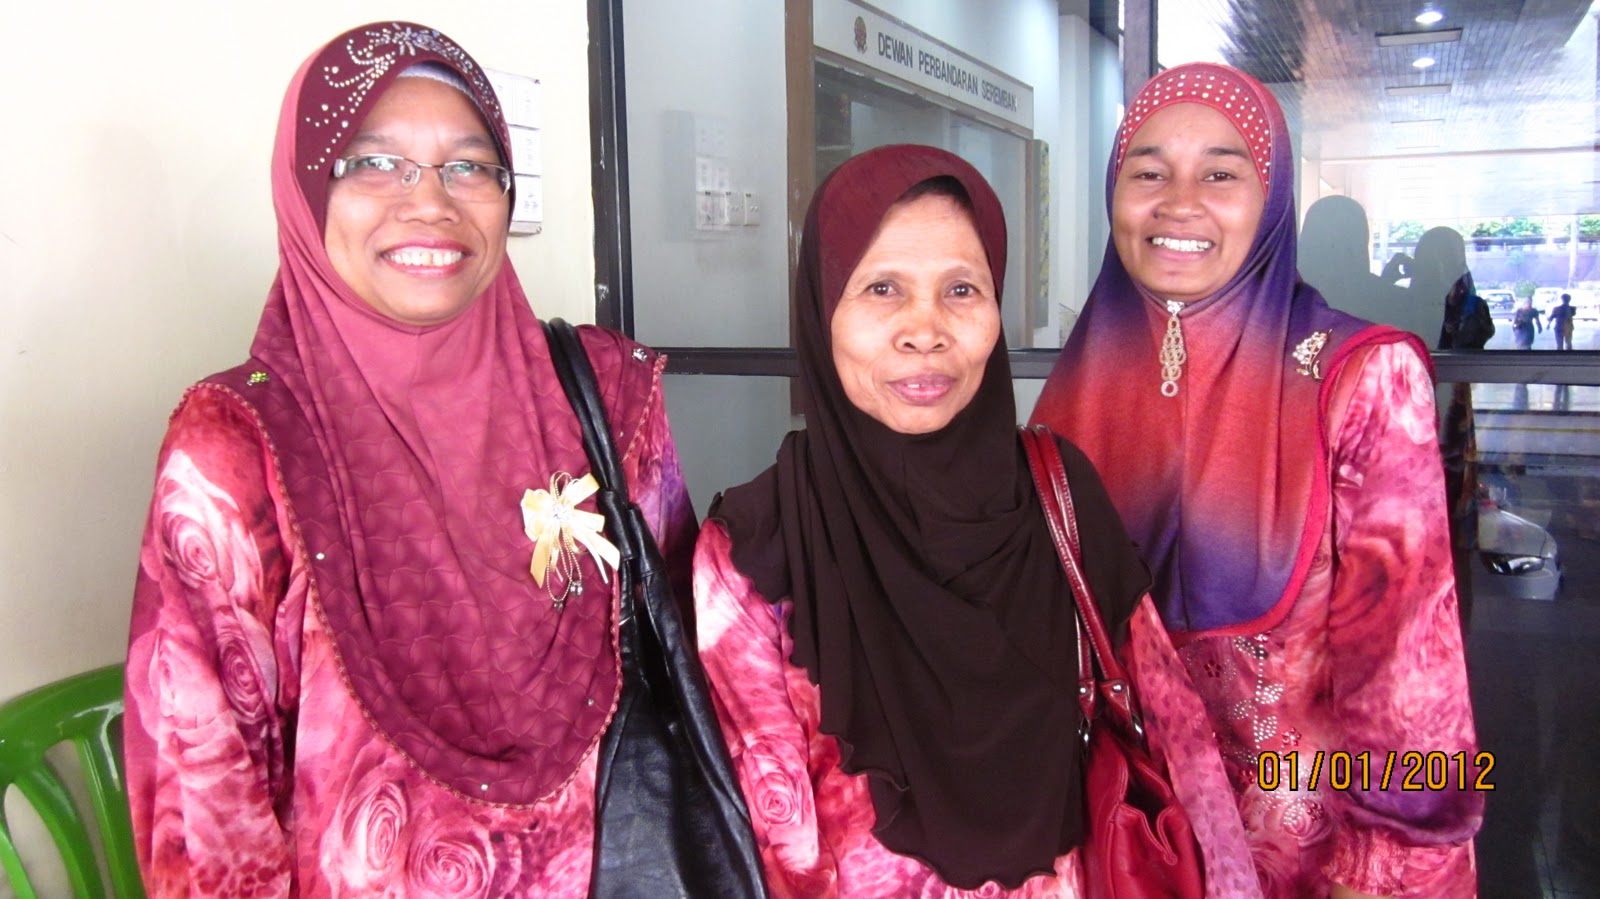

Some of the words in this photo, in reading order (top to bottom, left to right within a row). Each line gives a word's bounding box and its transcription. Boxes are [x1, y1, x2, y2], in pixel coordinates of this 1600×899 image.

[878, 32, 913, 68] DEWAN
[918, 51, 978, 96] PERBANDARAN
[981, 79, 1017, 112] SEREMBAN
